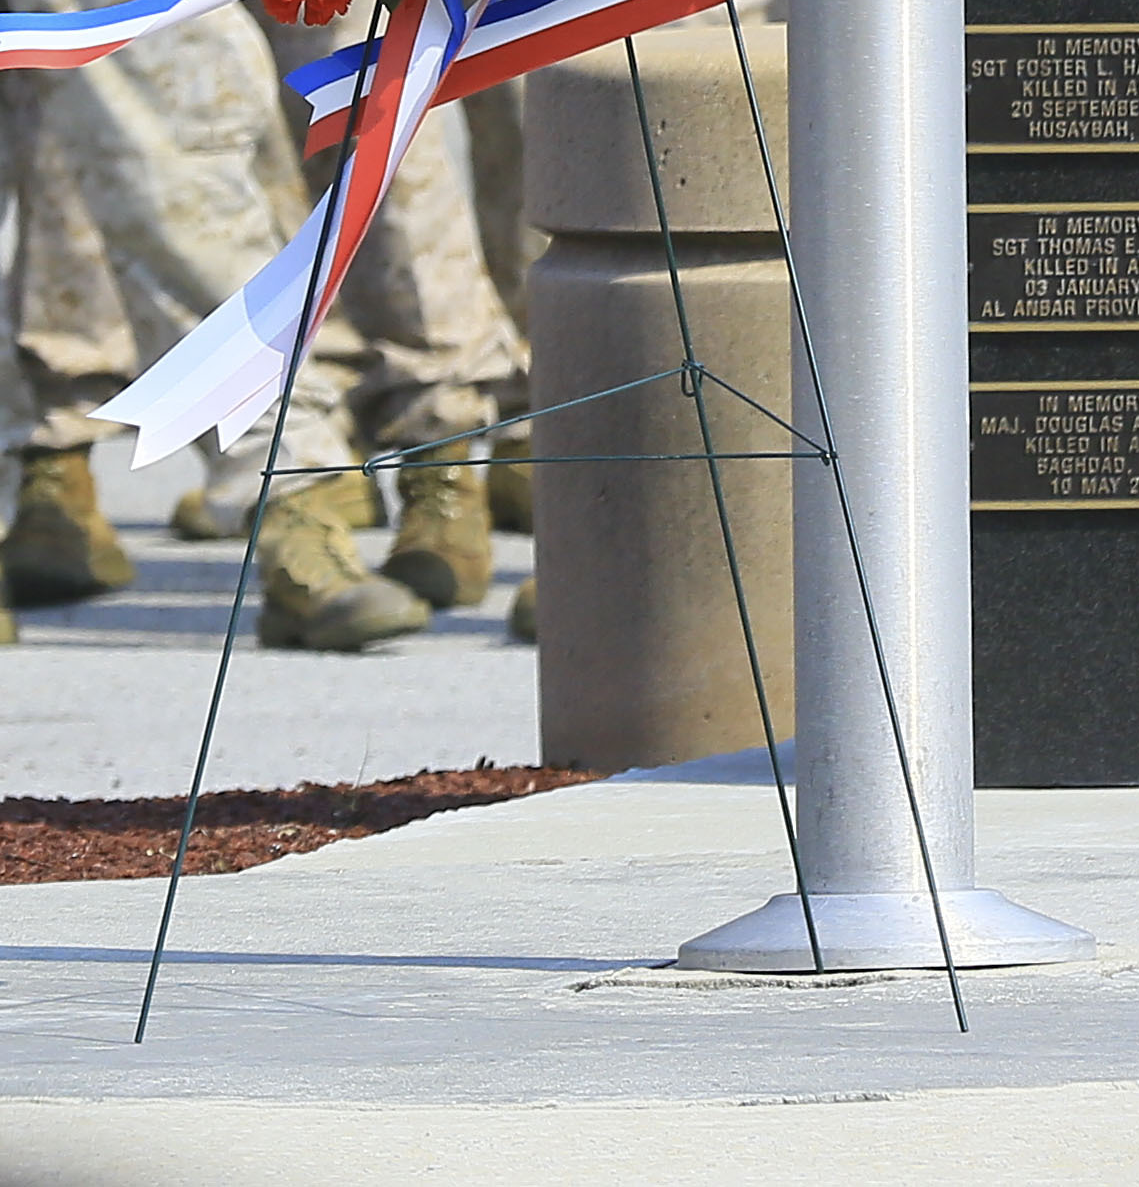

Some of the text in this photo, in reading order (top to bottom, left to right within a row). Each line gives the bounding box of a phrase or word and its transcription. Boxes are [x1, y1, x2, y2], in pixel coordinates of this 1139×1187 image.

[972, 60, 1007, 76] SGT
[1017, 58, 1087, 77] FOSTER
[1097, 58, 1112, 75] L.
[1023, 78, 1087, 97] KILLED
[1098, 78, 1116, 96] IN
[1011, 100, 1032, 117] 20
[1029, 119, 1134, 140] HUSAYBAH,
[993, 238, 1029, 255] SGT
[1037, 236, 1115, 255] THOMAS
[1125, 237, 1139, 254] E.
[1024, 257, 1089, 276] KILLED
[1099, 256, 1118, 274] IN
[1025, 278, 1048, 296] 03
[982, 300, 1005, 317] AL
[1013, 298, 1075, 316] ANBAR
[1025, 435, 1089, 454] KILLED
[1100, 435, 1118, 452] IN
[1050, 476, 1071, 494] 10
[1081, 476, 1121, 494] MAY
